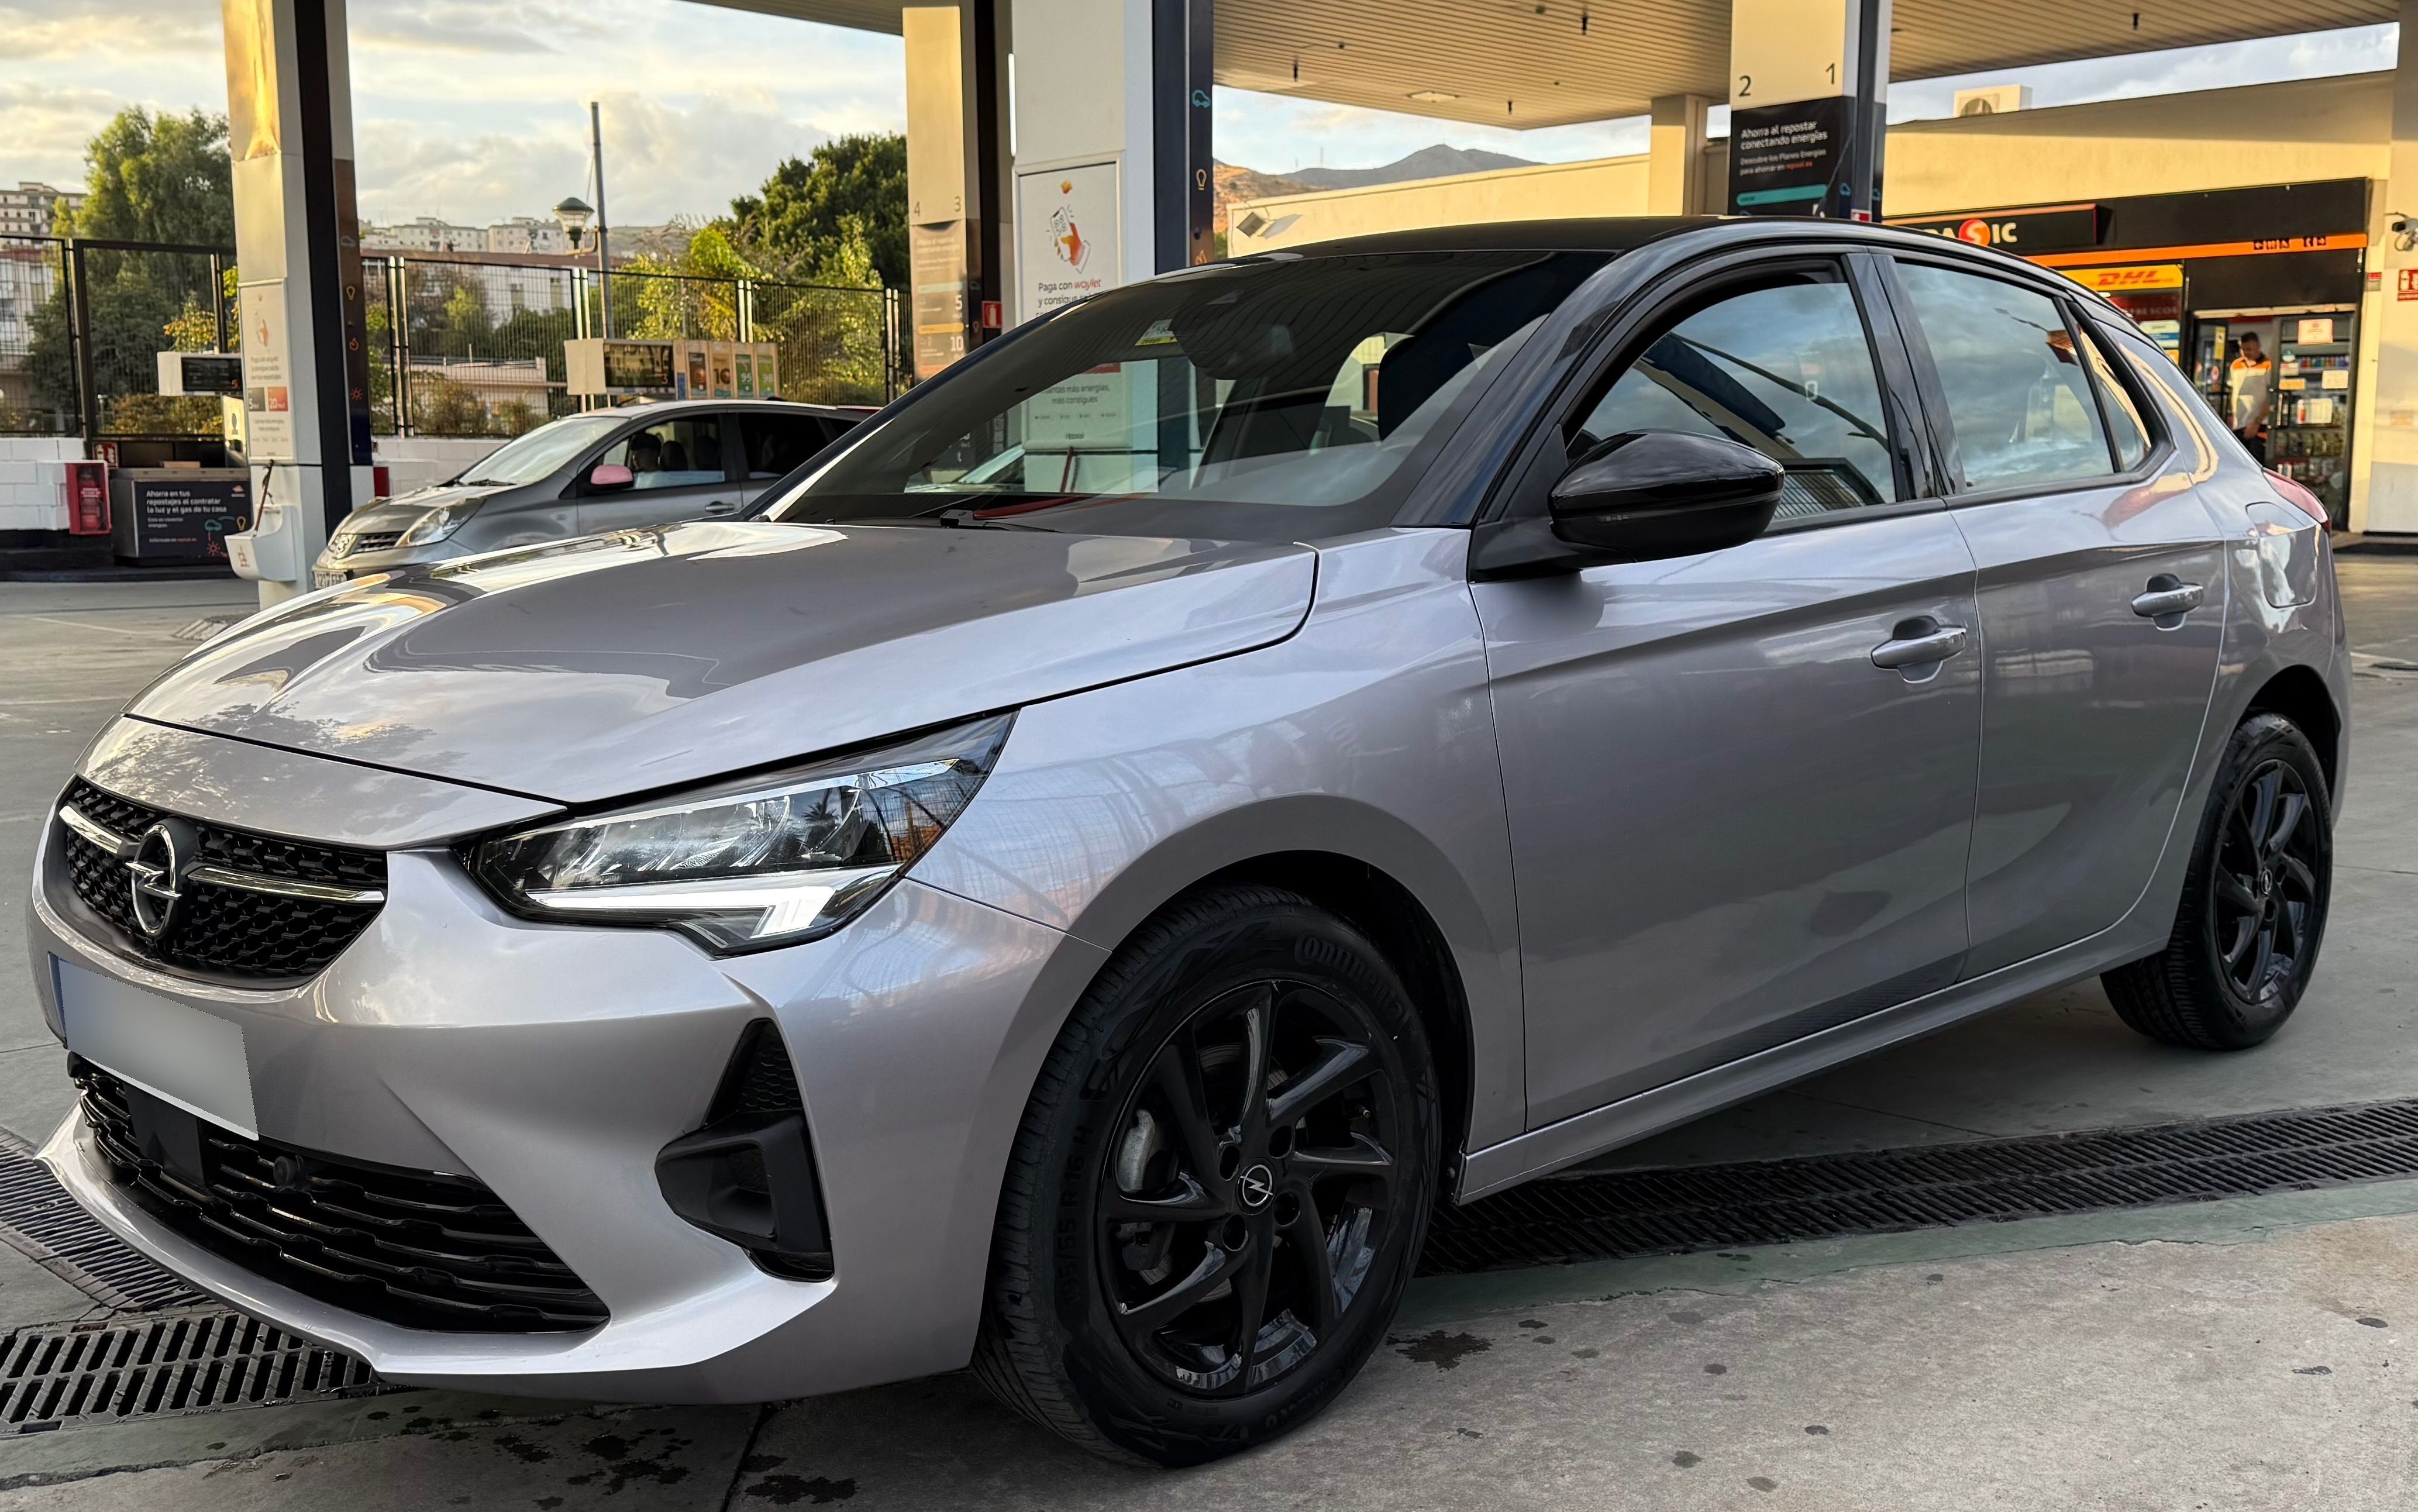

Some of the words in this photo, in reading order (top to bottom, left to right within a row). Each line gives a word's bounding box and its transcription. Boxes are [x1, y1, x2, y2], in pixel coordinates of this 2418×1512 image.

[1738, 75, 1751, 97] 2
[1826, 63, 1835, 85] 1
[1741, 128, 1769, 139] Ahorra
[1771, 125, 1779, 135] al
[1780, 121, 1817, 135] repostar
[1740, 136, 1790, 150] conectando
[1791, 130, 1828, 143] energías
[914, 201, 921, 216] 4
[955, 196, 962, 212] 3
[1038, 283, 1057, 293] Paga
[1073, 278, 1101, 290] waylet
[2097, 271, 2161, 285] DHL
[955, 294, 962, 311] 5
[1038, 299, 1043, 308] y
[950, 335, 964, 351] 10
